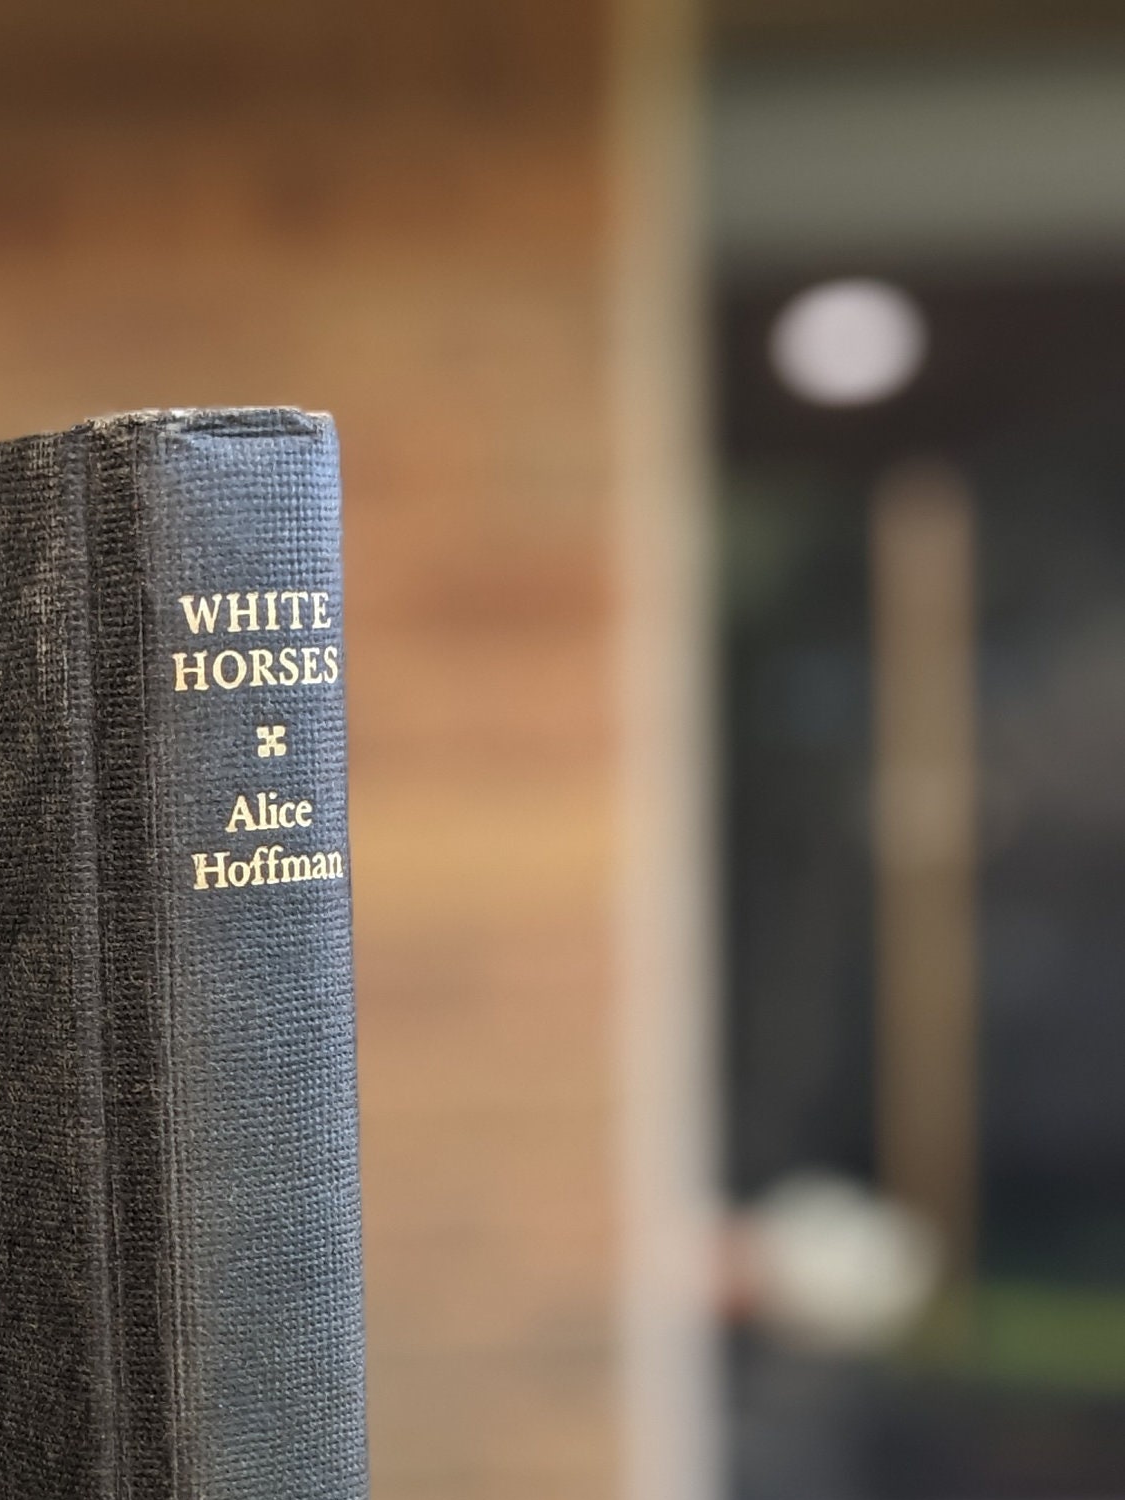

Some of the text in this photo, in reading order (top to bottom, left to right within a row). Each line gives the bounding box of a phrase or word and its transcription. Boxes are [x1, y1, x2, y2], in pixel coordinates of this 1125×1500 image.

[178, 591, 332, 634] WHITE
[172, 647, 339, 691] HORSES
[225, 792, 313, 833] Alice
[191, 845, 344, 890] Hoffman
